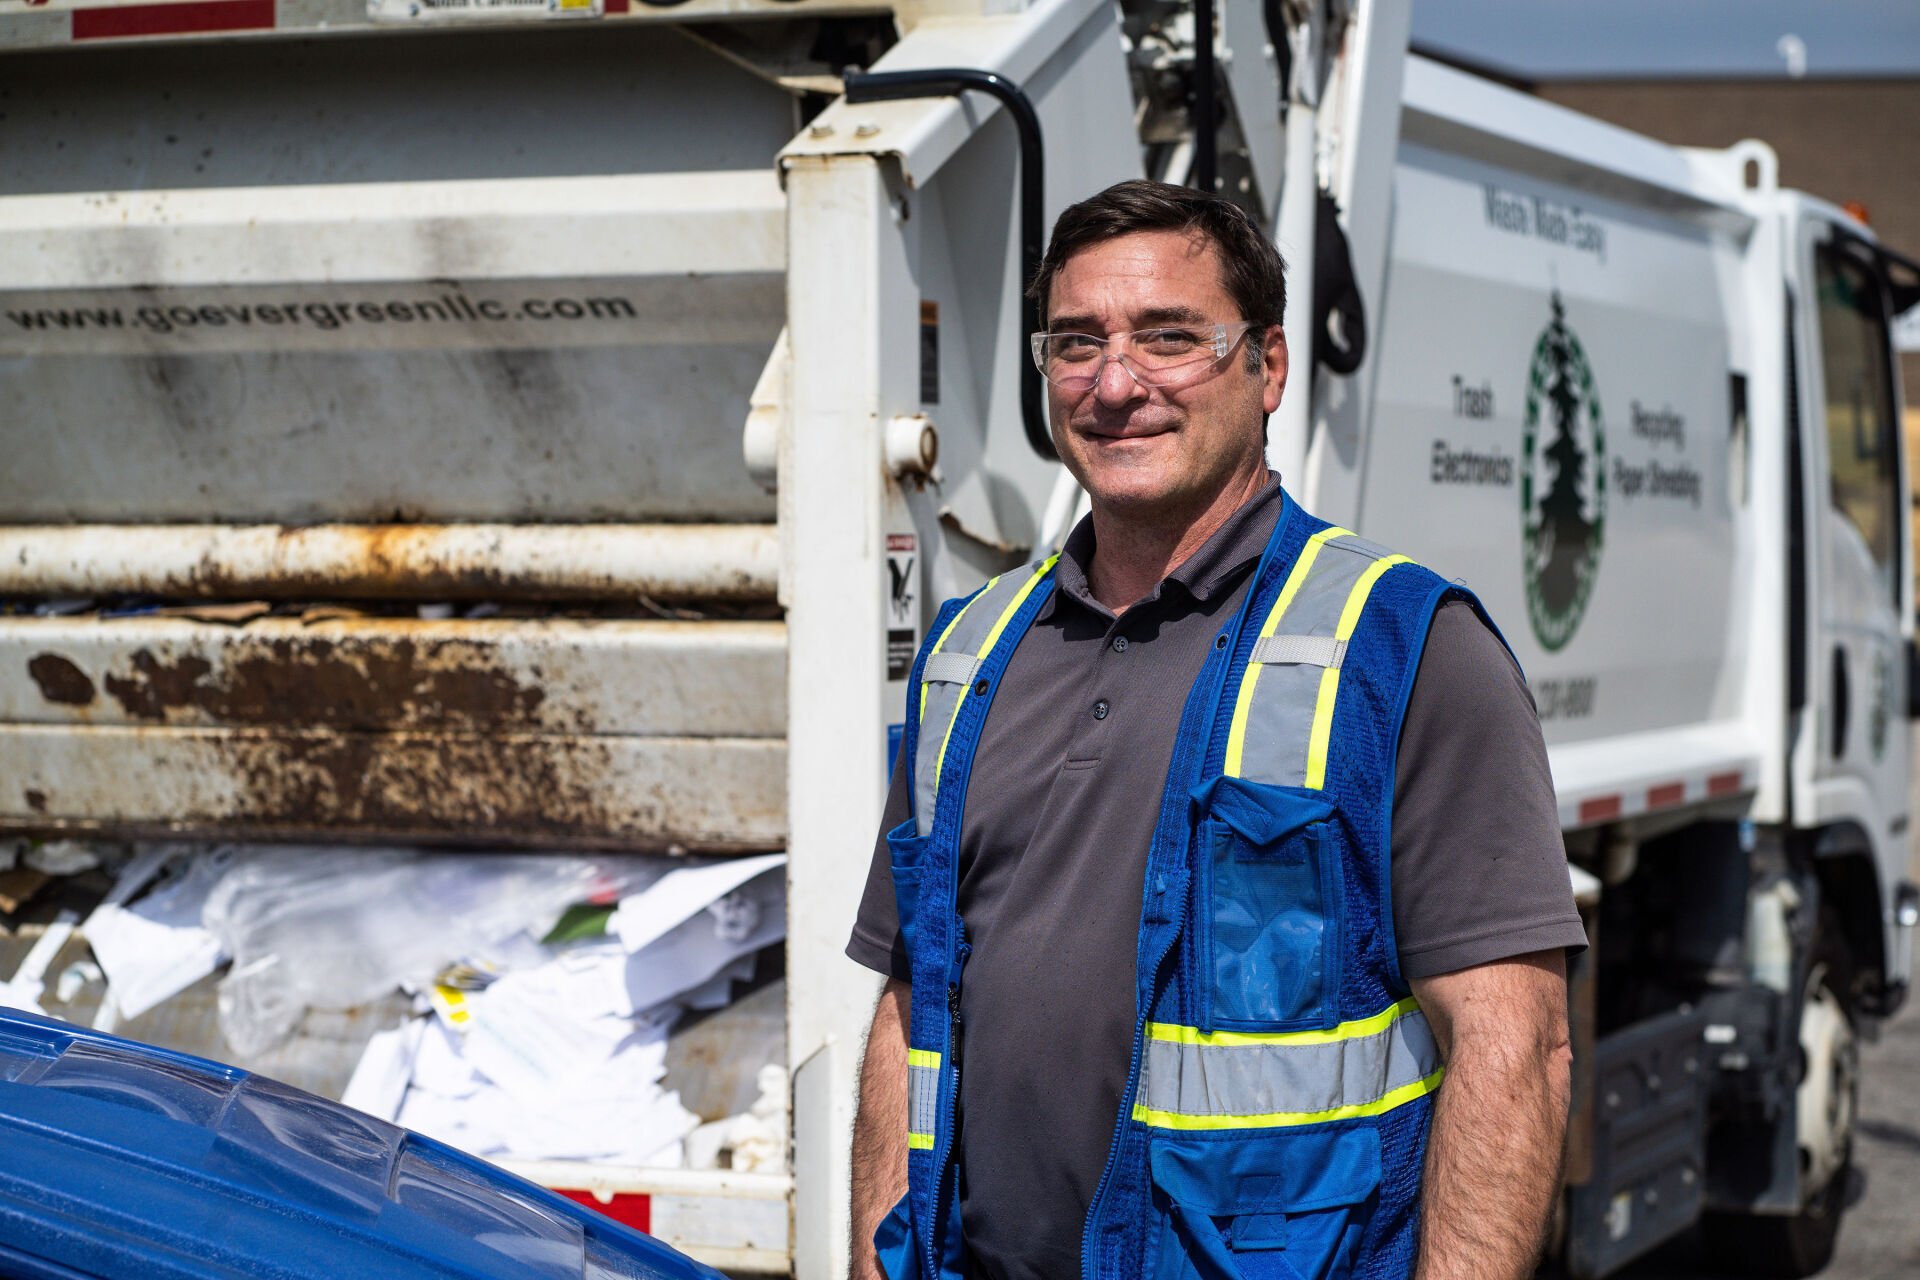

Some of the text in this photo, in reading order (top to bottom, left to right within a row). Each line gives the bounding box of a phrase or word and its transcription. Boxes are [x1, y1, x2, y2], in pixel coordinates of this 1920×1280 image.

[5, 295, 637, 334] www.goevergreenllc.com
[1452, 375, 1495, 420] Trash
[1431, 439, 1514, 487] Electronics
